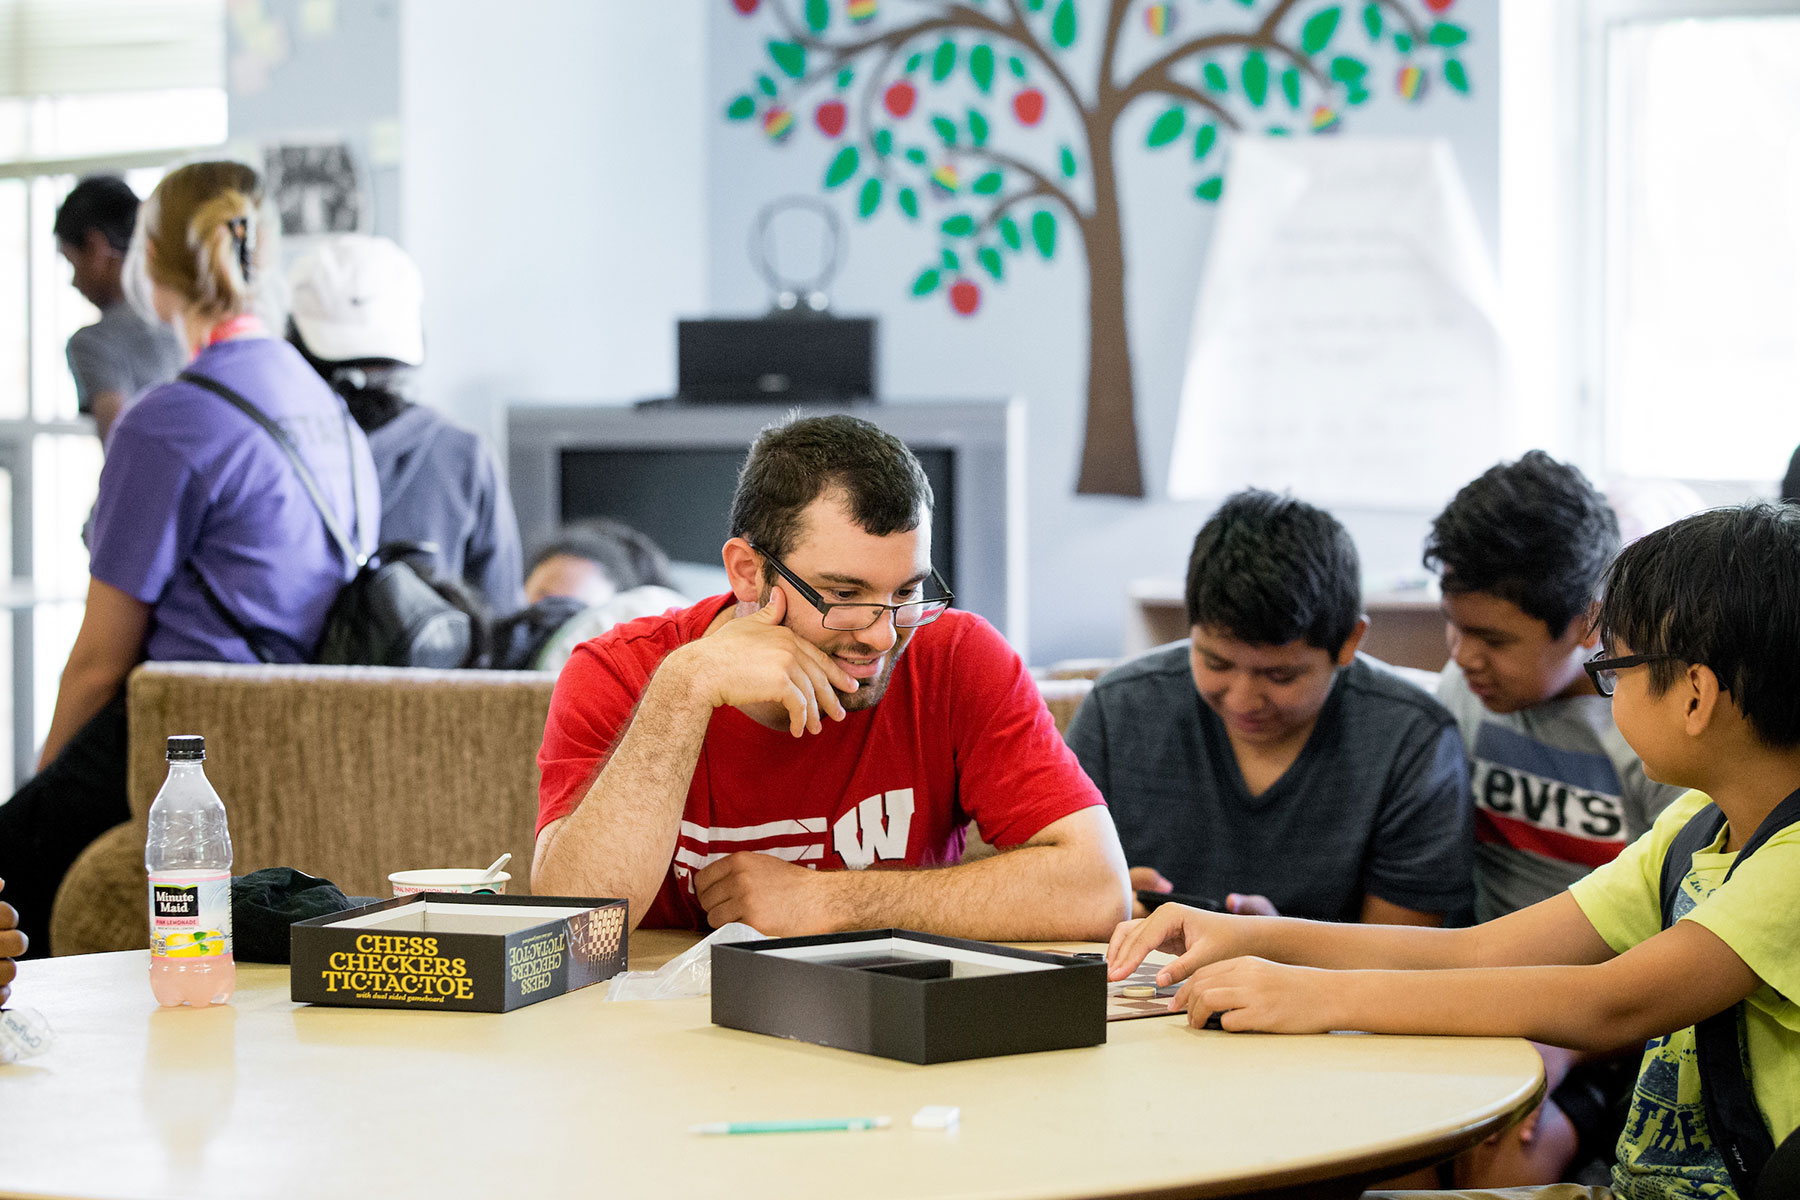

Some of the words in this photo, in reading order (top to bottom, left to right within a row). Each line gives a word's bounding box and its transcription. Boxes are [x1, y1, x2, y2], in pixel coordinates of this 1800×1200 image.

[832, 787, 914, 870] W
[156, 891, 194, 902] Minute
[160, 902, 189, 913] Maid
[356, 934, 439, 956] CHESS
[329, 952, 467, 977] CHECKERS
[511, 953, 562, 982] CHECKERS
[521, 972, 551, 995] CHESS
[372, 992, 388, 1000] dual
[388, 993, 407, 1001] sided
[406, 995, 445, 1003] gameboard
